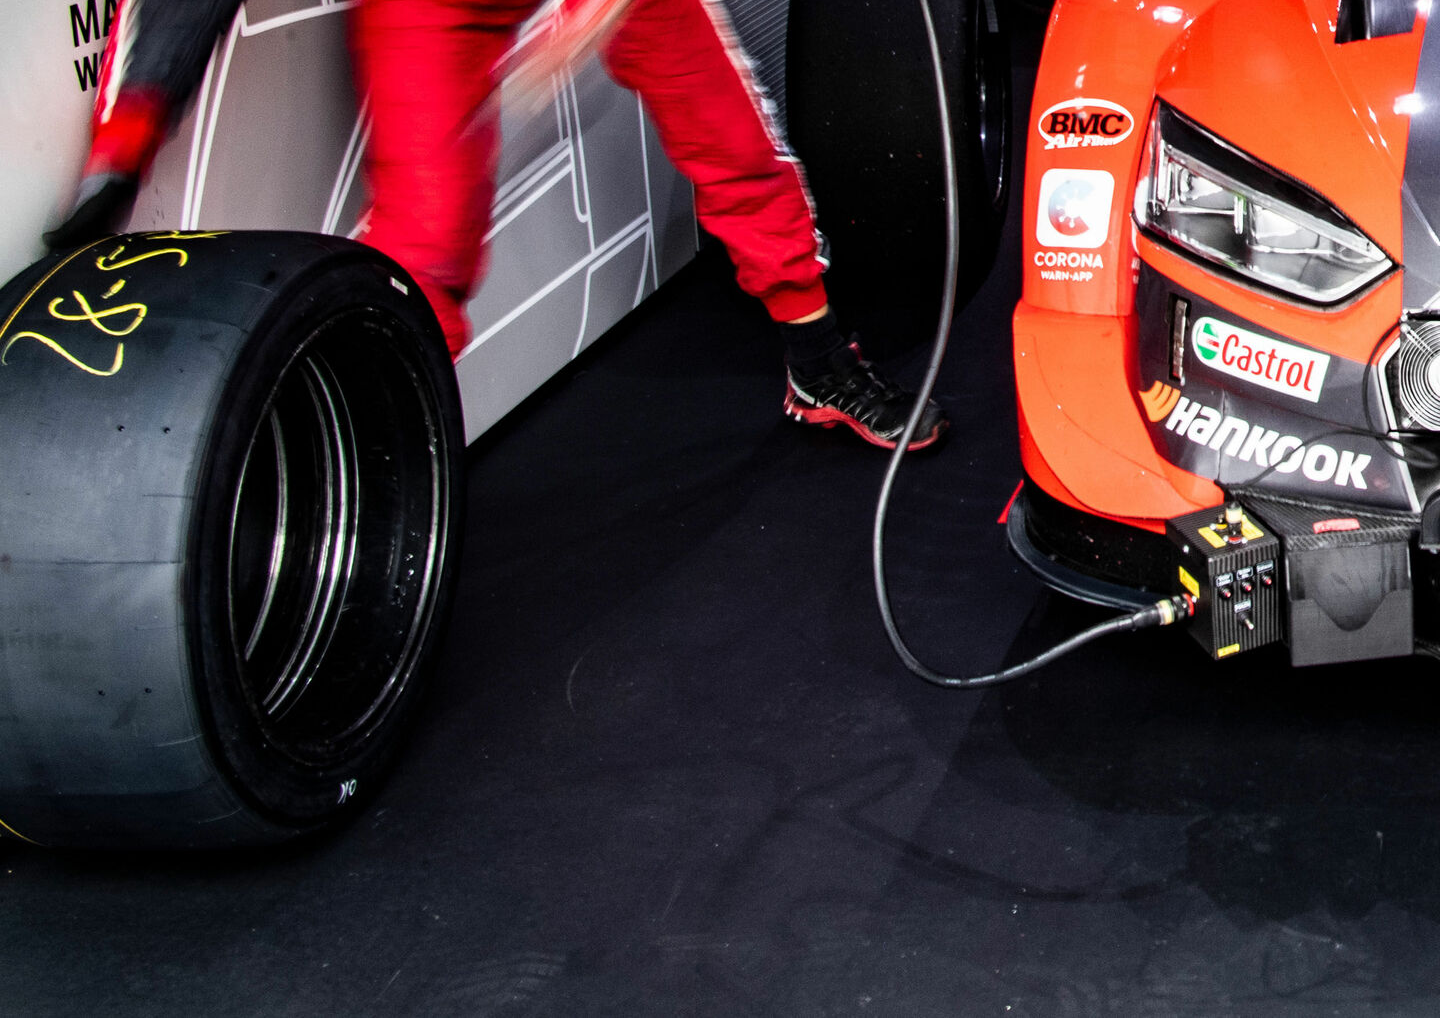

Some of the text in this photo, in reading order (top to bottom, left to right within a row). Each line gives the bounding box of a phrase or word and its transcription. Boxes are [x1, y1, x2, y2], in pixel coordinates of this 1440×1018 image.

[1047, 112, 1124, 135] BMC
[1044, 133, 1082, 150] Air
[1034, 251, 1104, 269] CORONA
[1222, 333, 1315, 392] Castrol
